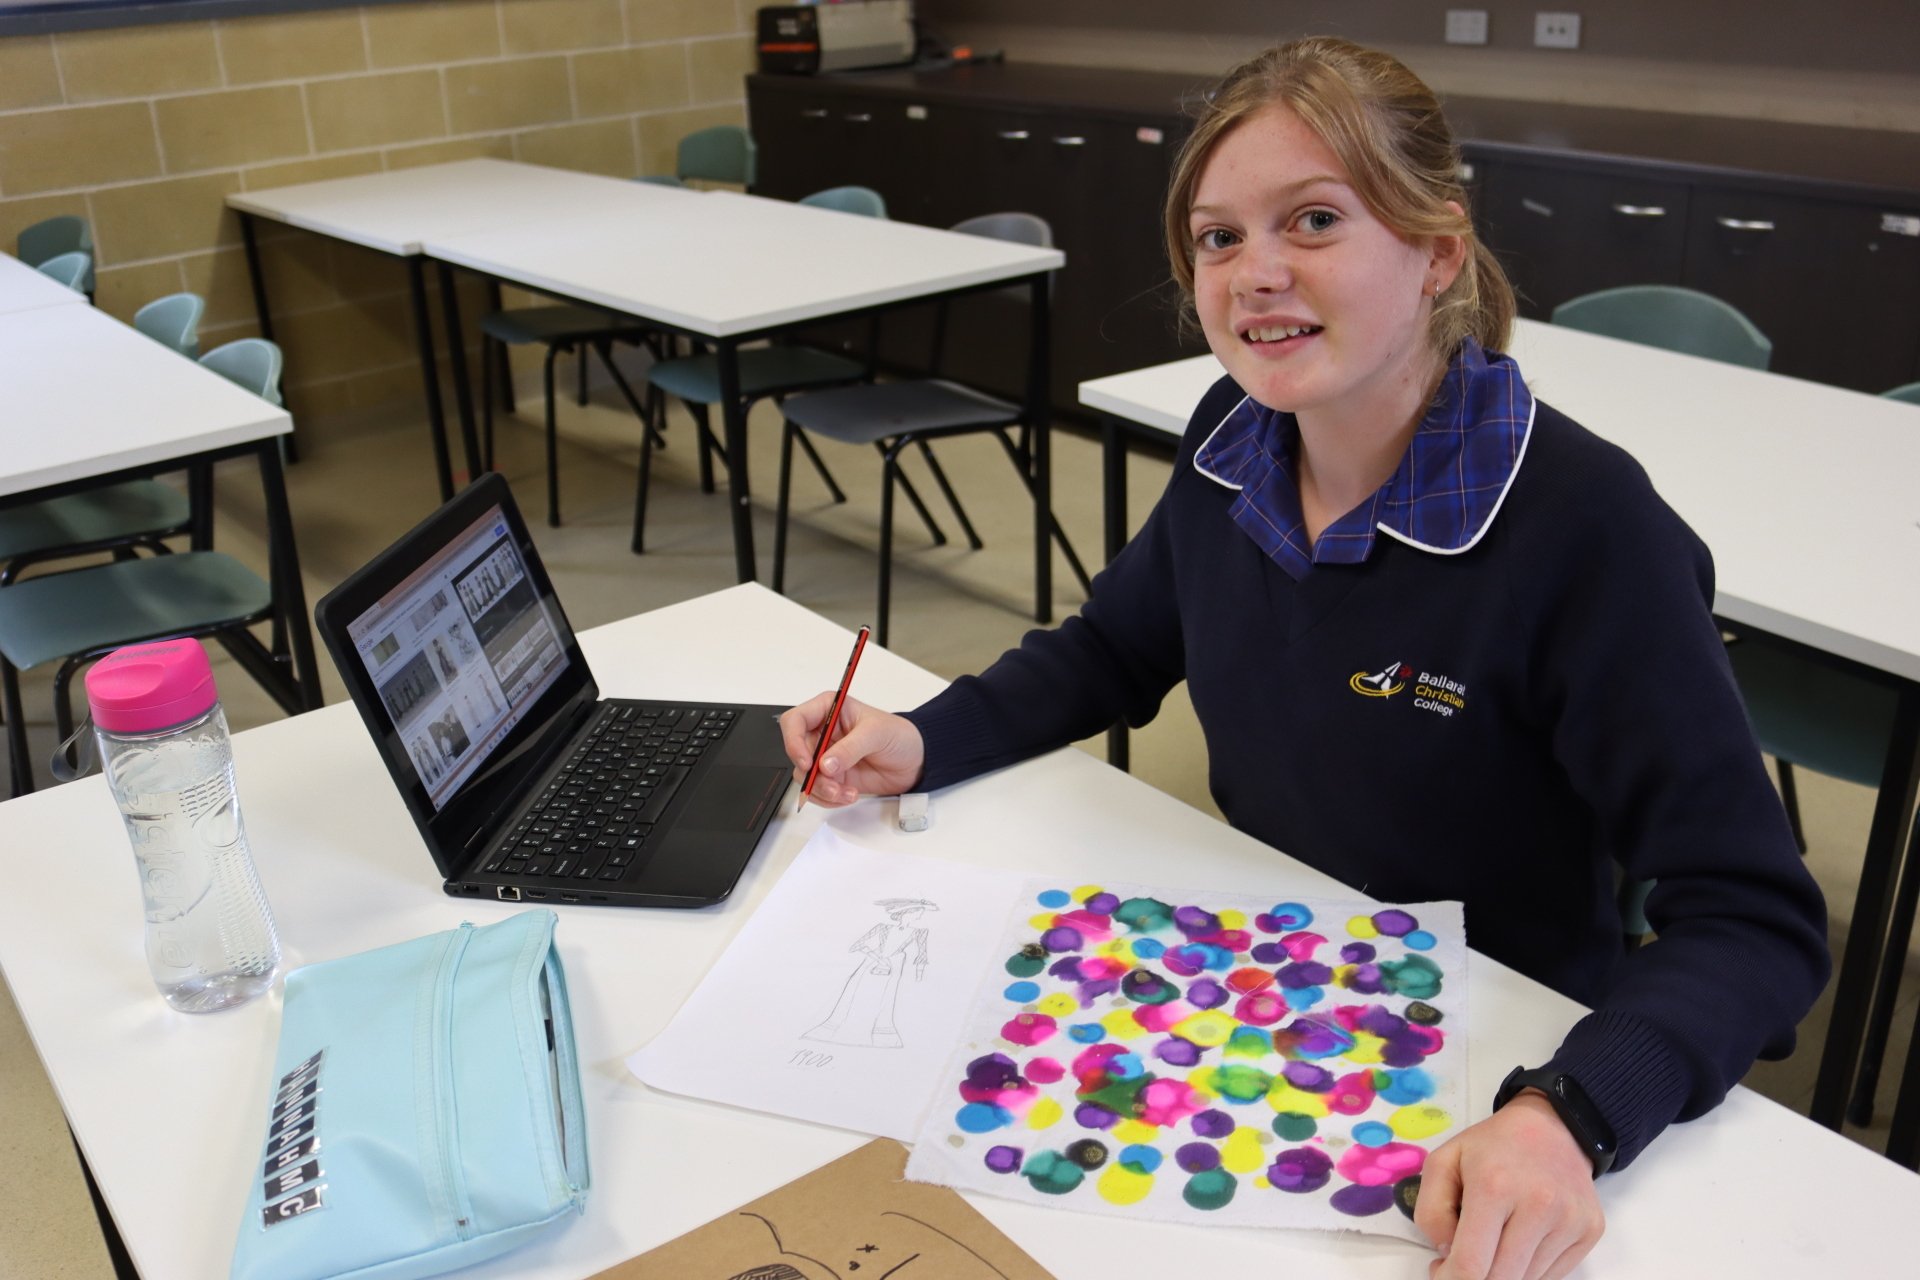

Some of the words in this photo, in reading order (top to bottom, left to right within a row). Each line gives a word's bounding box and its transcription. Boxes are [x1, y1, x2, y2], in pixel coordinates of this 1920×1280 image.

[1413, 697, 1454, 717] College
[1415, 685, 1465, 709] Christian
[788, 1048, 834, 1068] 1900
